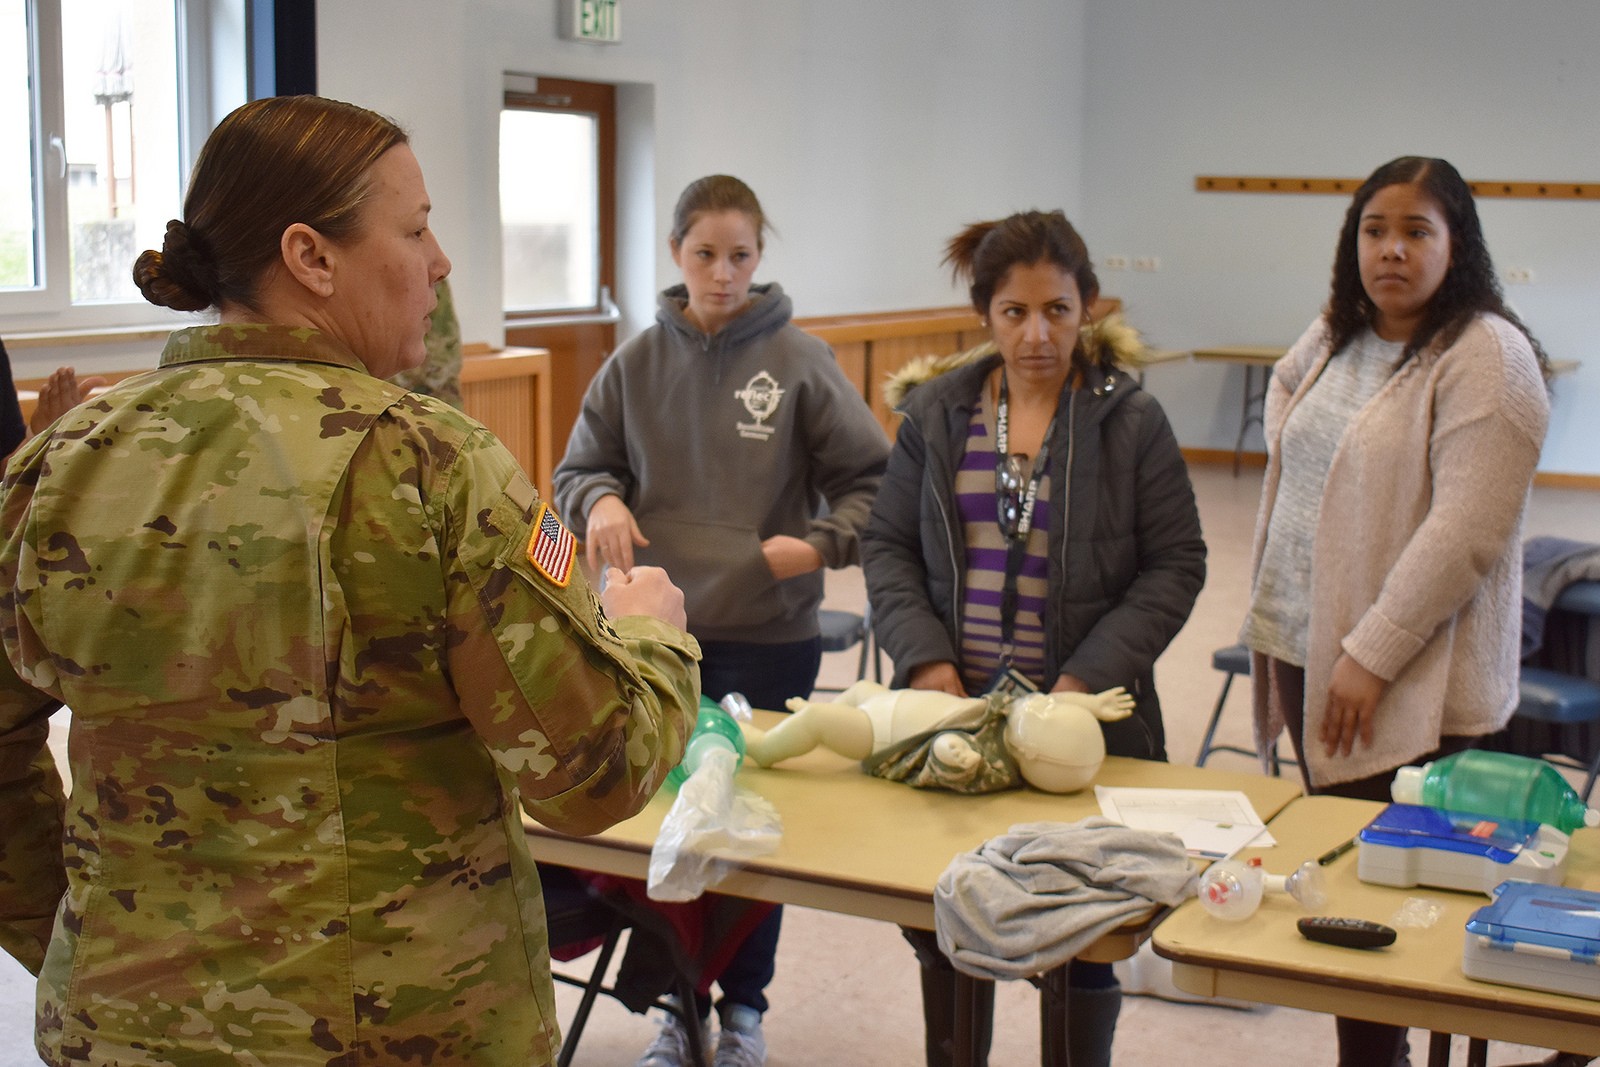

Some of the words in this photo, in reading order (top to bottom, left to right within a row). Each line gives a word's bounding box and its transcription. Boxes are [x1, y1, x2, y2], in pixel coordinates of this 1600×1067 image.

[581, 0, 617, 37] EXIT
[997, 404, 1008, 453] SHARP
[1018, 480, 1038, 533] SHARP
